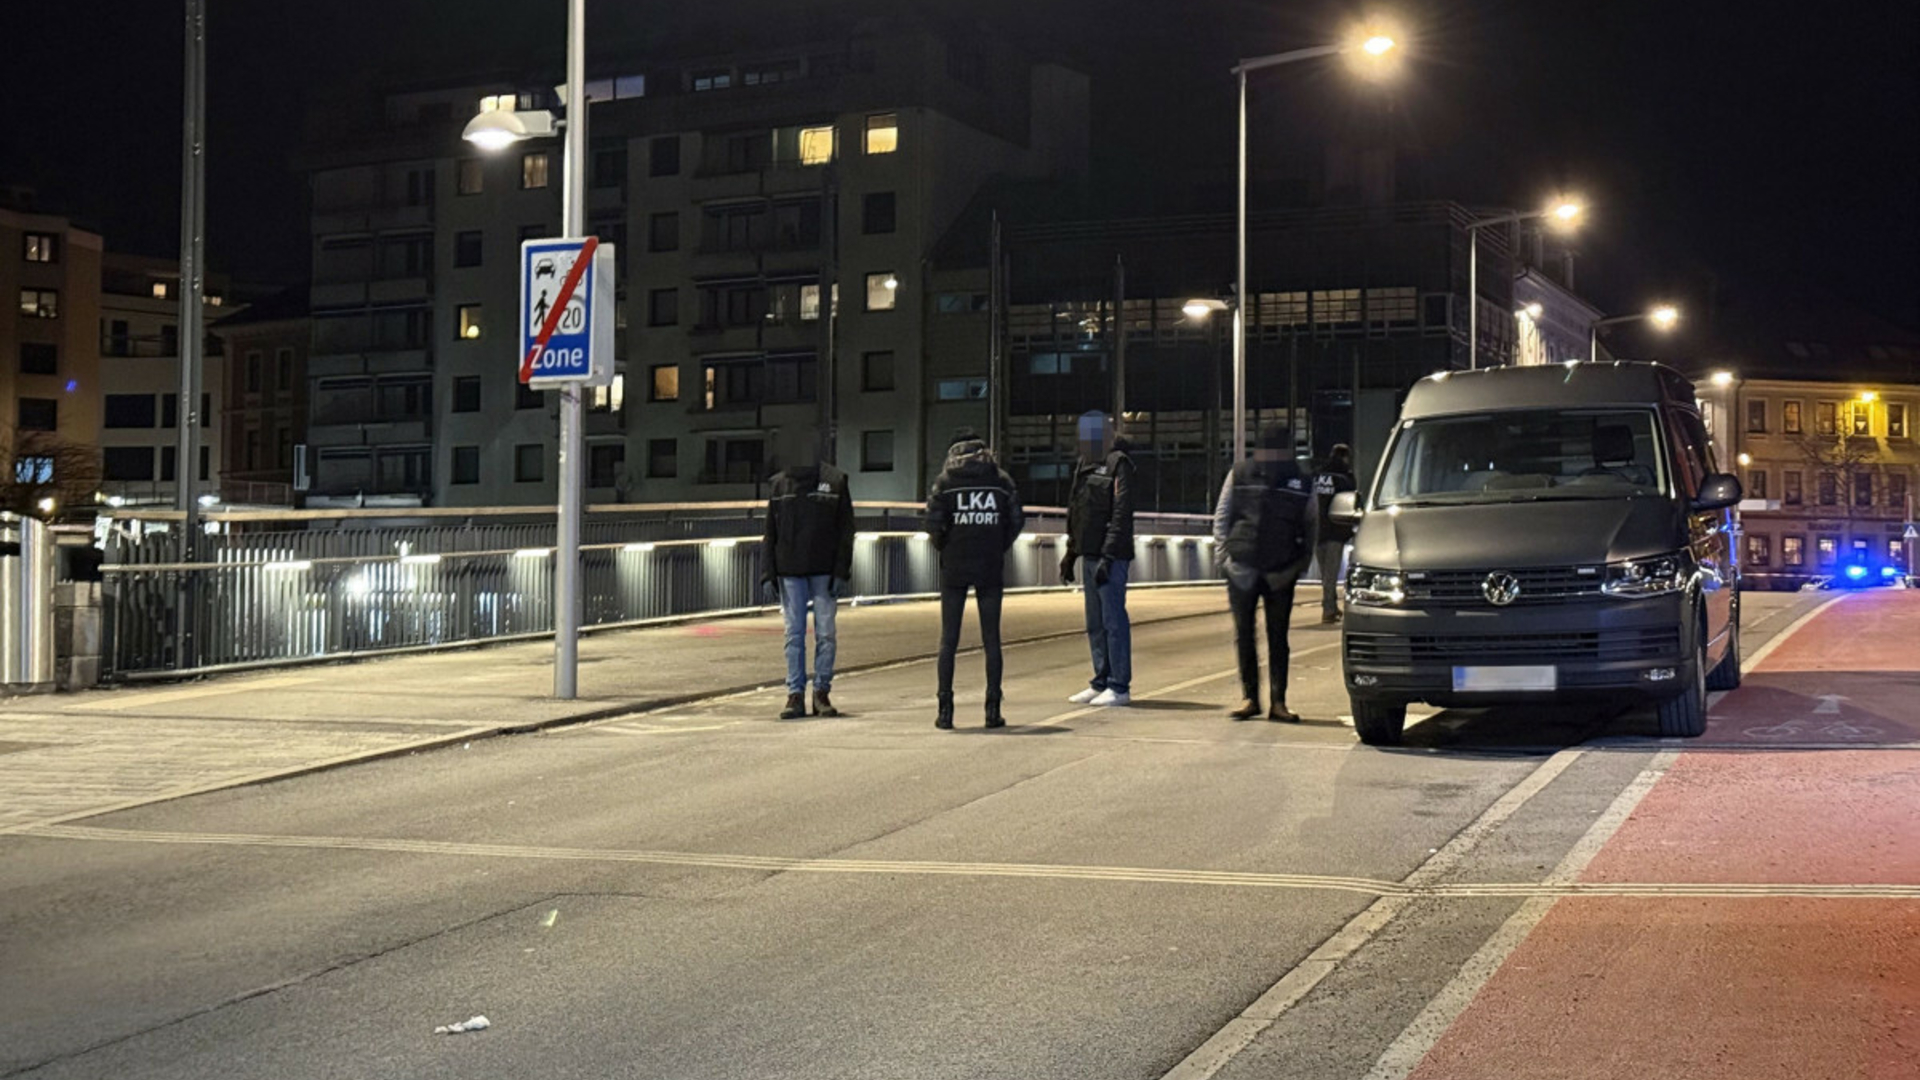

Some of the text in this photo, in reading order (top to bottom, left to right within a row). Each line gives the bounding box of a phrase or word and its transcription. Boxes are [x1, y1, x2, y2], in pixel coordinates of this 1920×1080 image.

[562, 307, 582, 329] 20
[530, 344, 583, 369] Zone
[957, 491, 997, 510] LKA
[952, 512, 1000, 525] TATORT
